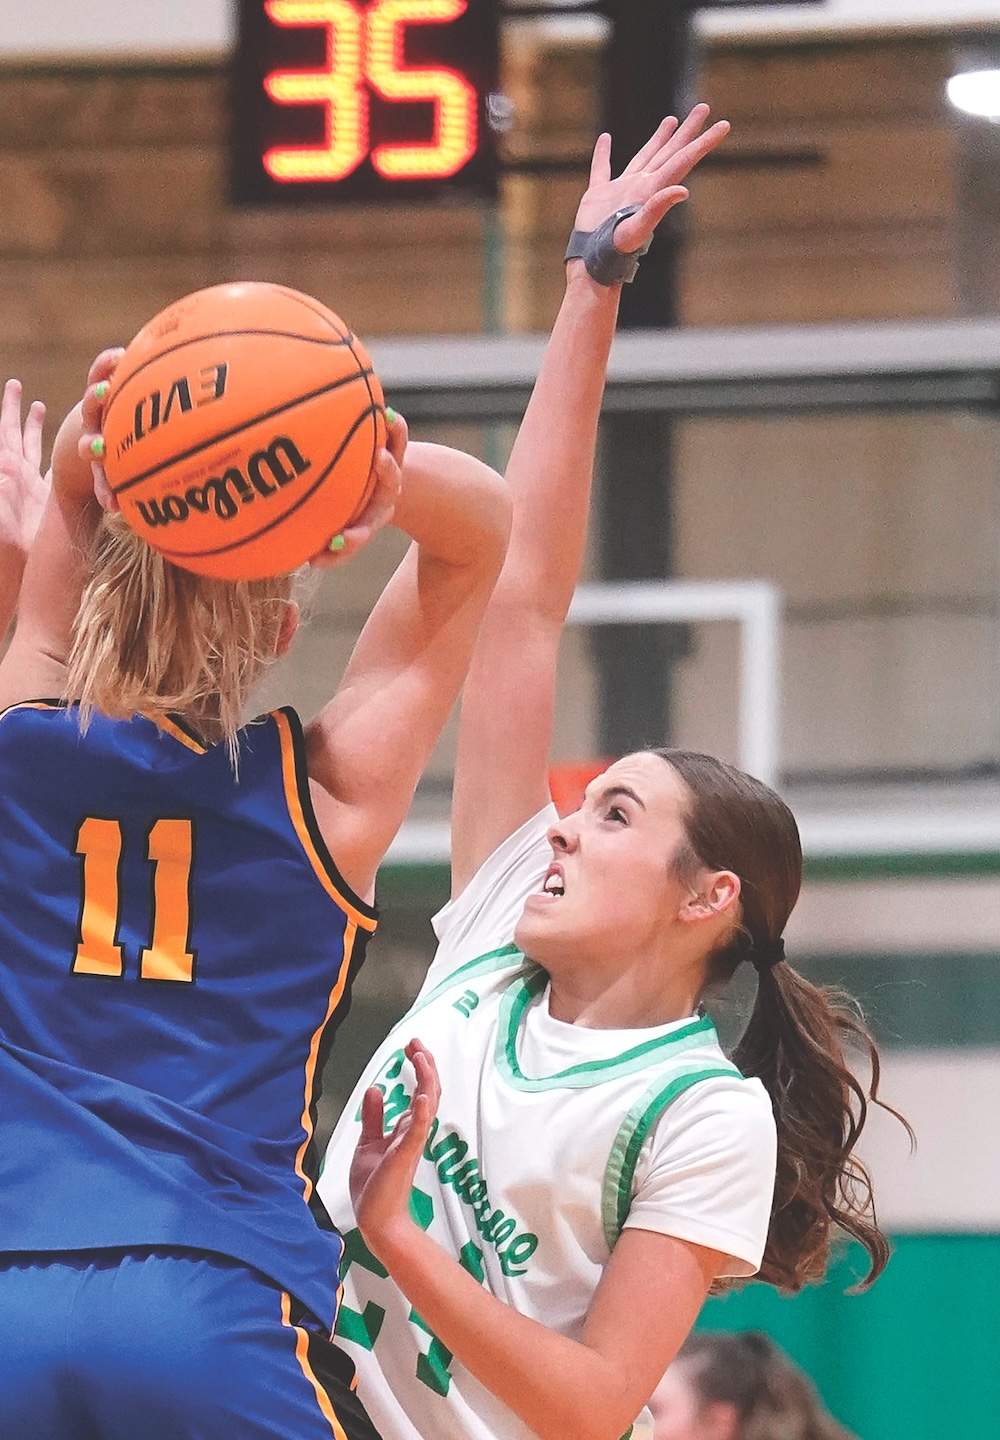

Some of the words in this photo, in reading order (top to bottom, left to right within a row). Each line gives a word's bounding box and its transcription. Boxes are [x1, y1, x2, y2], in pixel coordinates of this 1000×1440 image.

[262, 0, 478, 182] 35
[133, 362, 230, 442] EVO
[136, 435, 311, 528] Wilson
[71, 815, 196, 984] 11
